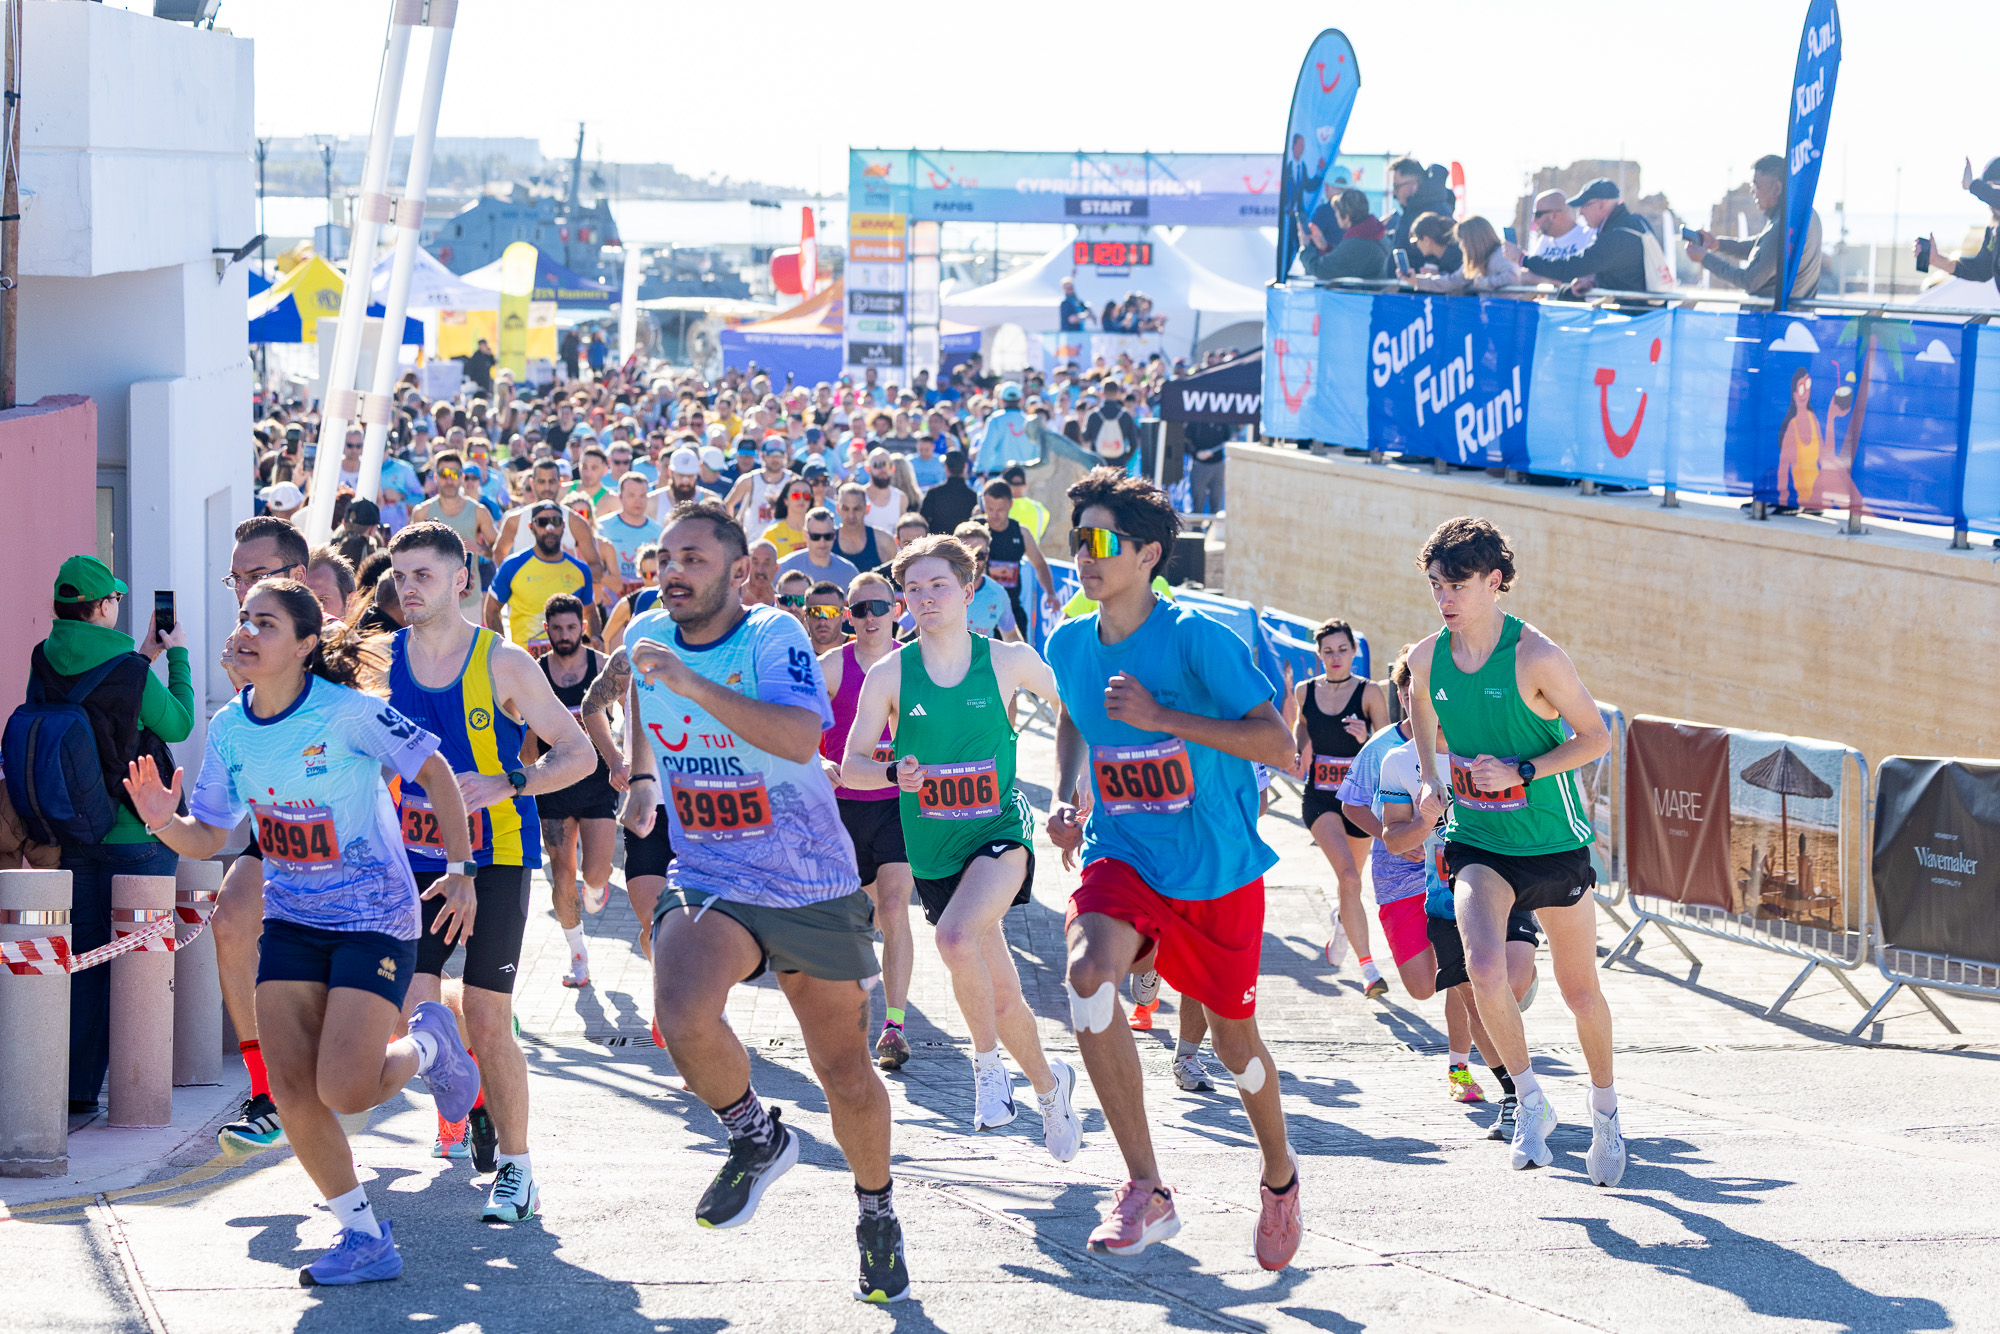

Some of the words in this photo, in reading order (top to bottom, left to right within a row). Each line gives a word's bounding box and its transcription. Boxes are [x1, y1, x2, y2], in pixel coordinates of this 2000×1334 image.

[1081, 201, 1133, 215] START
[1372, 296, 1434, 388] Sun!
[1414, 333, 1474, 428] Fun!
[1455, 365, 1522, 463] Run!
[698, 734, 735, 749] TUI
[663, 756, 745, 776] CYPRUS
[1101, 759, 1187, 798] 3600
[1453, 767, 1513, 799] 30
[922, 775, 993, 807] 3006
[1654, 787, 1704, 821] MARE
[676, 791, 763, 827] 3995
[262, 818, 331, 859] 3994
[408, 811, 475, 845] 32
[1913, 846, 1978, 875] Wavemaker
